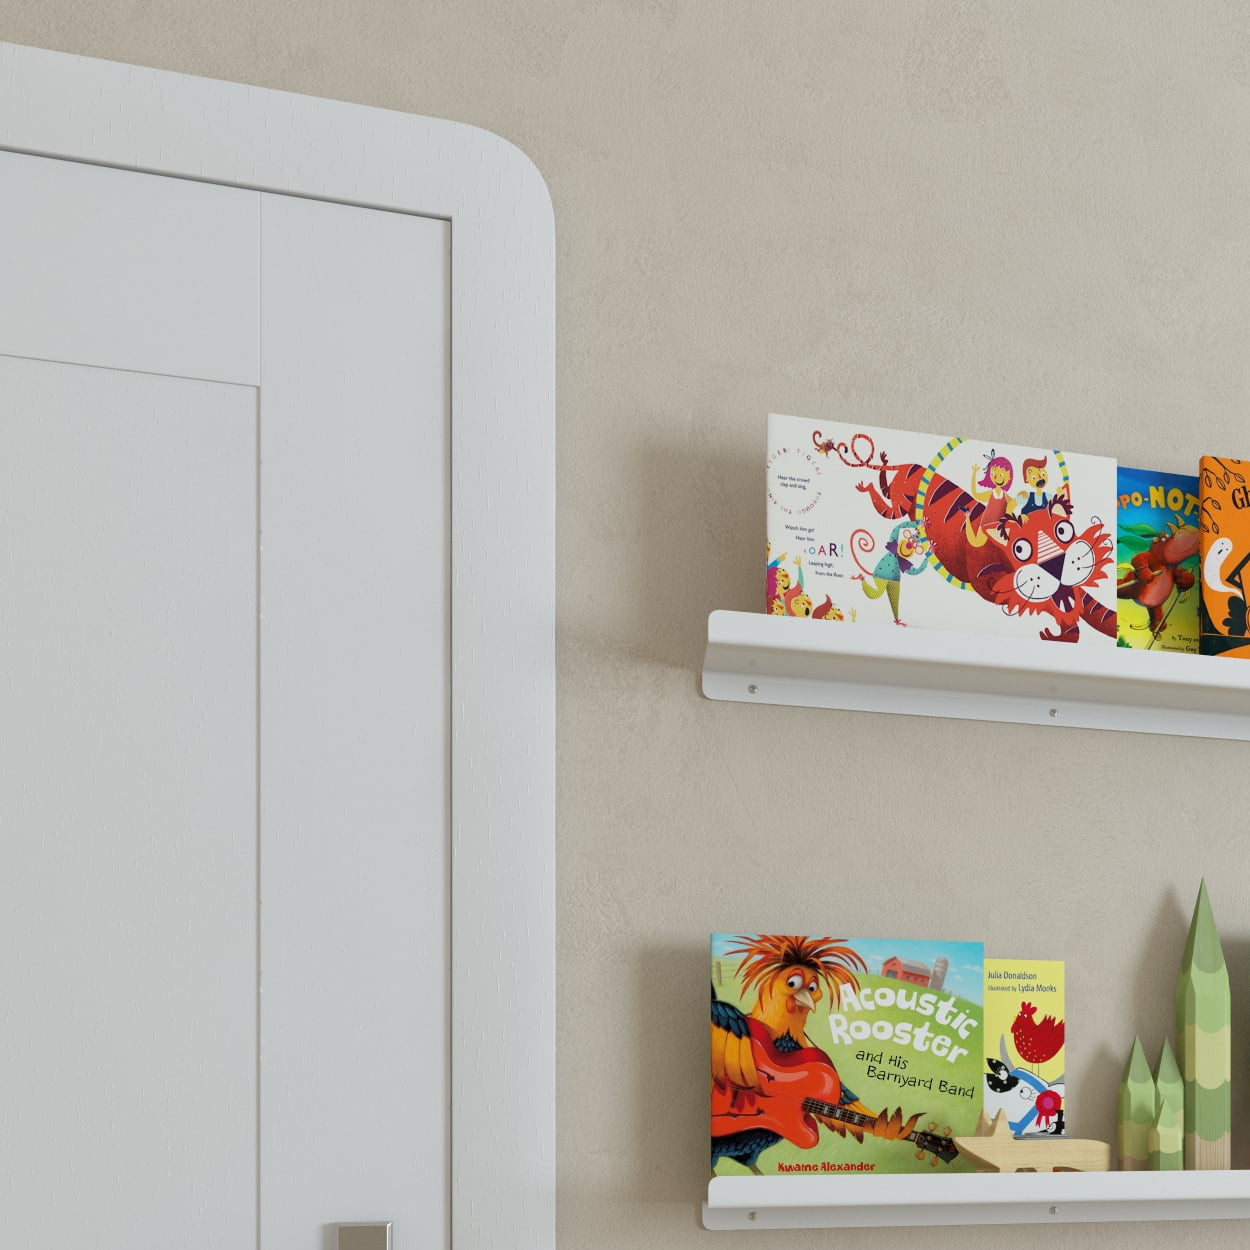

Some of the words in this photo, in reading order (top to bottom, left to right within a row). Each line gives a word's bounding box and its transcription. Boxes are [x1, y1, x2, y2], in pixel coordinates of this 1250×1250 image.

[987, 971, 1002, 979] Julia
[1003, 971, 1037, 980] Donaldson
[1018, 983, 1034, 993] Lydia
[1036, 983, 1056, 992] Monks
[839, 982, 978, 1040] Acoustic
[828, 1013, 969, 1064] Rooster
[855, 1050, 883, 1064] and
[888, 1055, 909, 1070] His
[866, 1065, 933, 1088] Barnyard
[938, 1080, 976, 1099] Band
[778, 1162, 818, 1172] Kwame
[821, 1161, 876, 1171] Alexander
